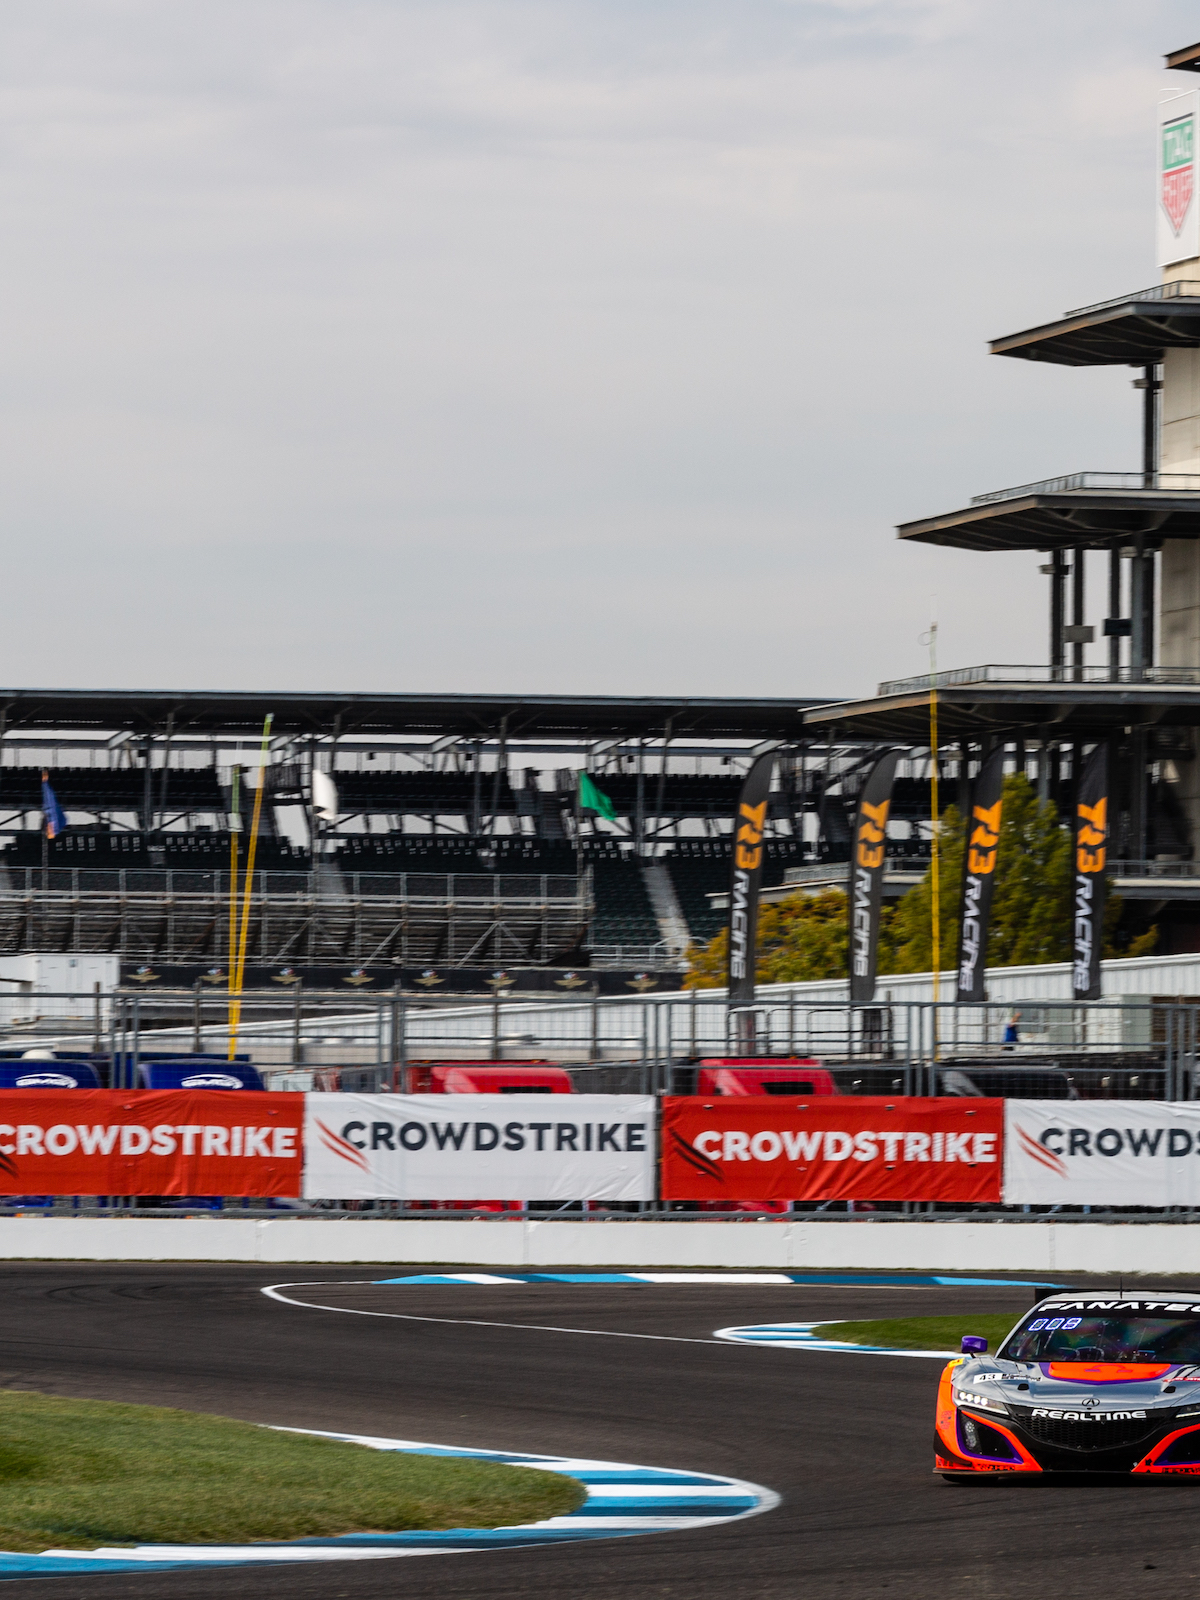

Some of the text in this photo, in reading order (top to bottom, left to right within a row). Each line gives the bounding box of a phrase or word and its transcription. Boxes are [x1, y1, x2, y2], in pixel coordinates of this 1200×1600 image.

[1164, 123, 1193, 164] TAG
[733, 801, 766, 980] TR3 RACING
[854, 800, 889, 977] TR3 RACING
[959, 800, 1001, 991] TR3 RACING
[1074, 797, 1107, 991] TR3 RACING
[341, 1120, 647, 1152] CROWDSTRIKE
[693, 1130, 997, 1163] CROWDSTRIKE
[1031, 1408, 1147, 1421] REALTIME
